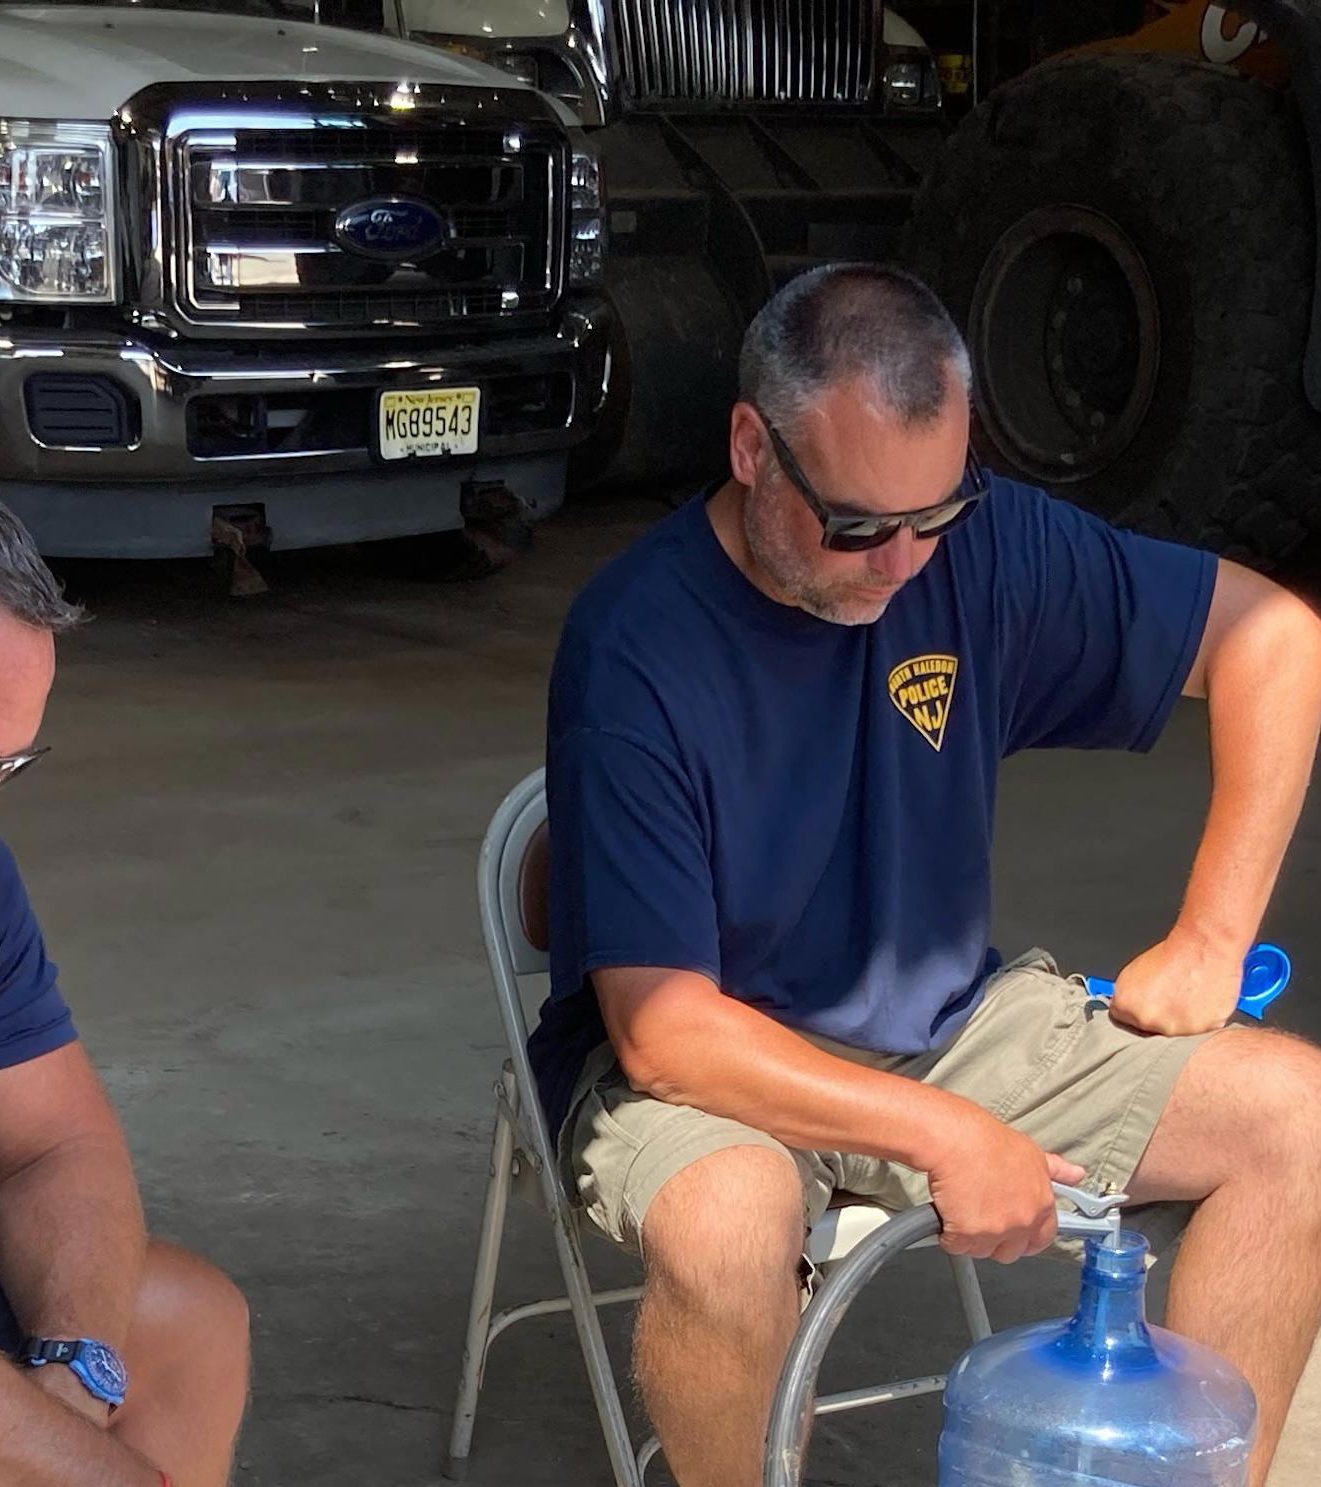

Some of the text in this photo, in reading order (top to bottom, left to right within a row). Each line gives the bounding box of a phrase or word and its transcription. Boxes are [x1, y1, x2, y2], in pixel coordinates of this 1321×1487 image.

[385, 404, 473, 441] MG89543
[898, 675, 949, 709] POLICE
[913, 699, 944, 732] NJ
